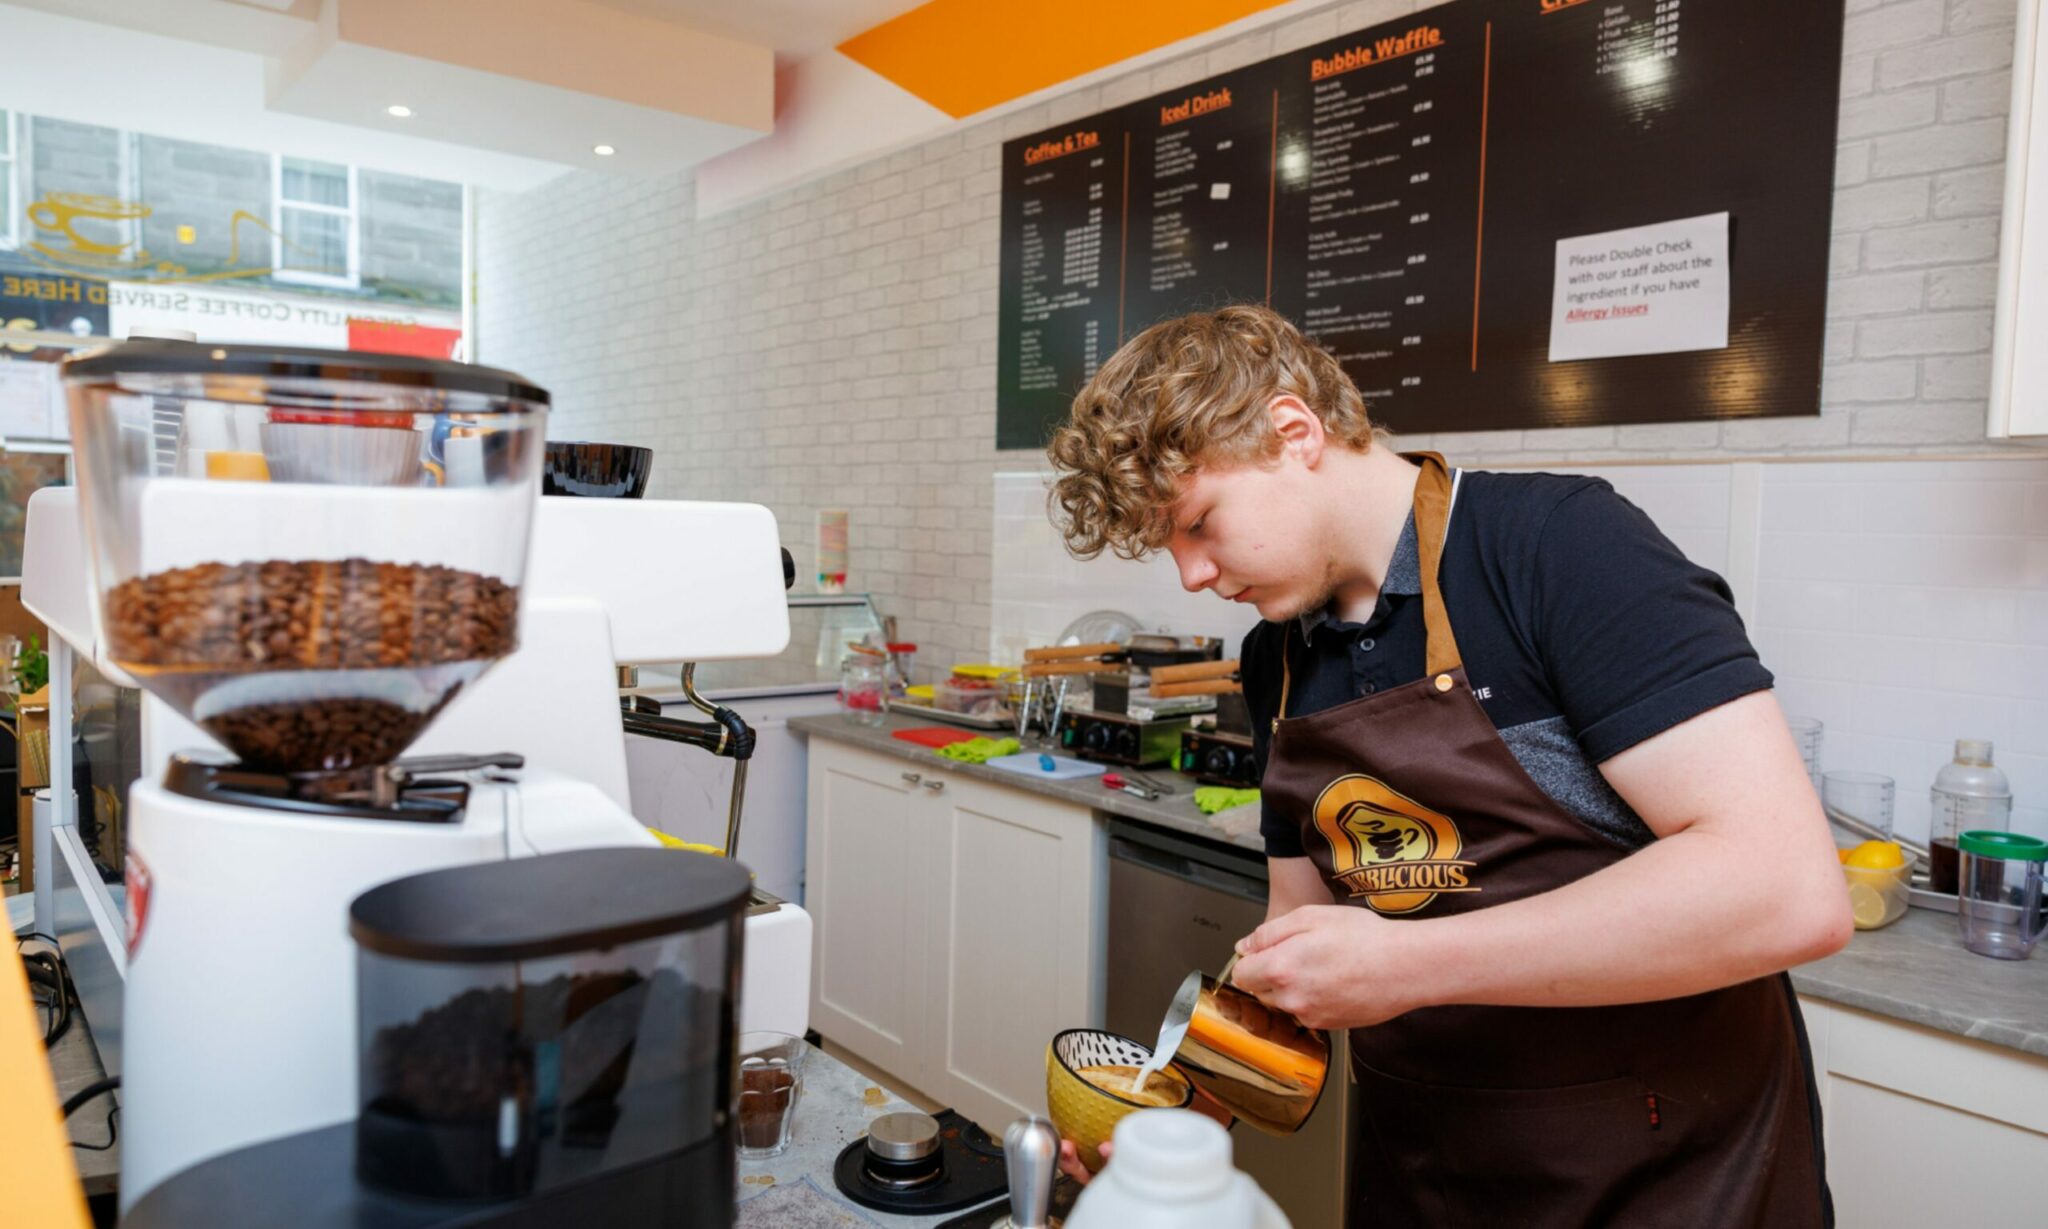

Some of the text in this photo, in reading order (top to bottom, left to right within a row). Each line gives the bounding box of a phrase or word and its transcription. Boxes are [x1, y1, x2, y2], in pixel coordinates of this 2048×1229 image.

[1311, 26, 1441, 79] Bubble Waffle
[1161, 88, 1232, 124] Iced Drink
[1024, 142, 1062, 164] Coffee
[1076, 132, 1099, 150] Tea
[1569, 238, 1693, 267] Please Double Check
[1568, 256, 1713, 285] with our staff about the
[1567, 277, 1700, 304] ingredient if you have
[1566, 304, 1649, 323] Allergy Issues
[1472, 687, 1492, 700] IE
